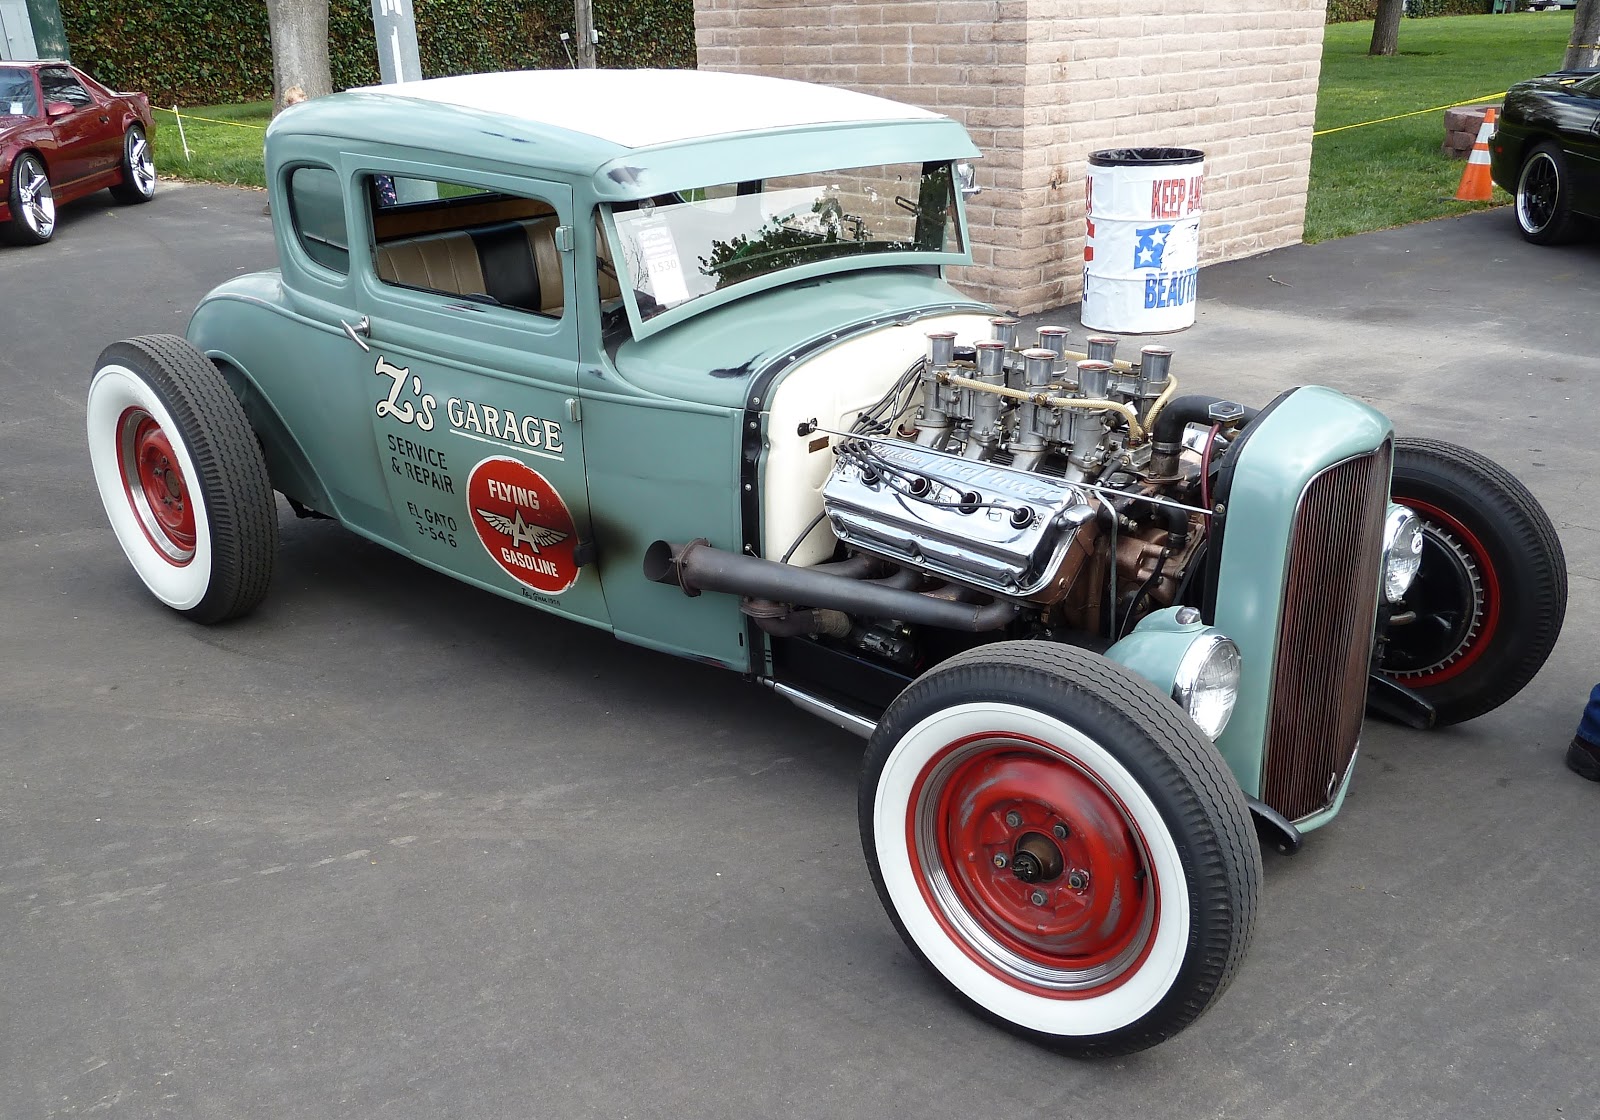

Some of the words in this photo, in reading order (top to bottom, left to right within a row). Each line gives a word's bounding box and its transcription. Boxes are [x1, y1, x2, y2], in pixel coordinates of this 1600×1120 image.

[1151, 178, 1186, 219] KEEP
[652, 259, 677, 273] 1530
[374, 355, 437, 431] Z's
[447, 397, 564, 453] GARAGE
[387, 434, 448, 470] SERVICE
[391, 457, 402, 475] &
[404, 461, 455, 494] REPAIR
[487, 478, 540, 511] FLYING
[407, 501, 423, 519] EL
[424, 508, 457, 532] GATO
[415, 521, 457, 548] 3-546
[500, 547, 559, 578] GASOLINE
